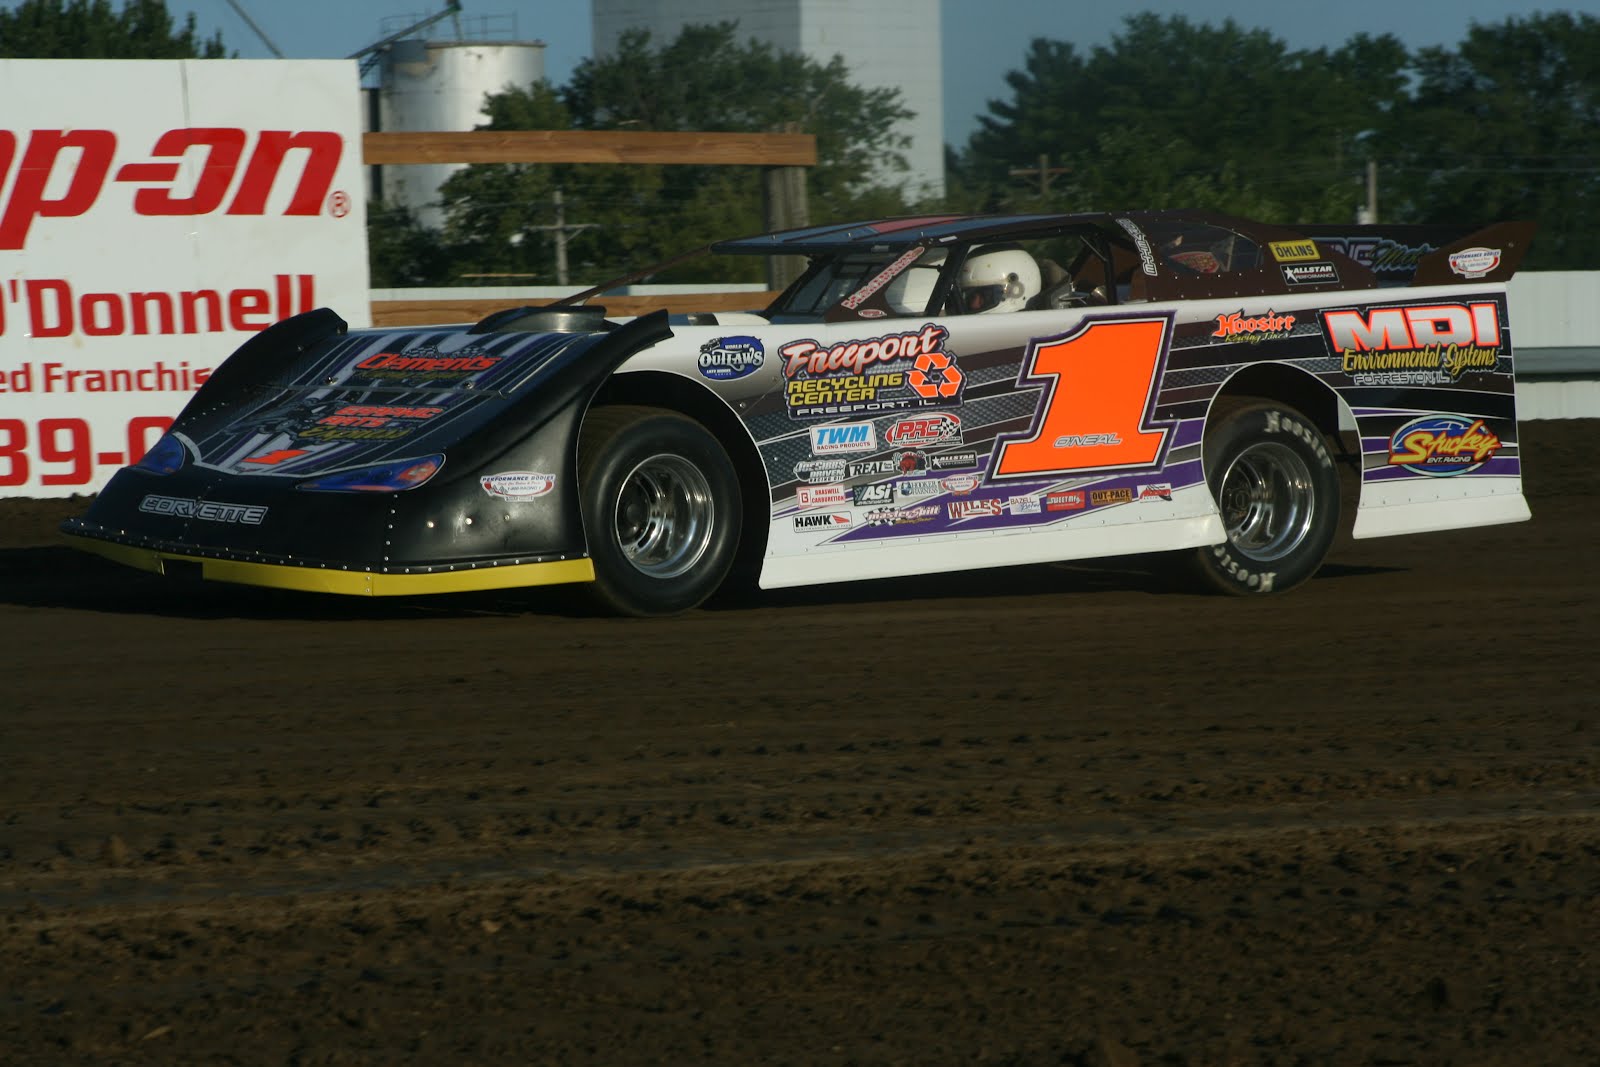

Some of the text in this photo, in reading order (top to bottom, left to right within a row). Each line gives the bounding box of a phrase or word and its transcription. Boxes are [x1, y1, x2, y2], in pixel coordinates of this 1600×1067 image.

[0, 128, 344, 251] p-on
[1274, 244, 1315, 257] ÖHLINS
[1293, 265, 1332, 274] ALLSTAR
[0, 274, 314, 338] 'Donnell
[1211, 310, 1296, 337] Hoosier
[1323, 303, 1500, 353] MDI
[356, 353, 502, 371] Clements
[783, 326, 943, 378] Freeport
[1343, 342, 1496, 375] Environmental Systems
[788, 373, 903, 394] RECYCLING
[790, 388, 875, 406] CENTER
[993, 317, 1168, 478] 1
[816, 425, 869, 445] TWM
[896, 419, 941, 440] PRC
[1390, 419, 1501, 463] Stuckey
[810, 469, 845, 479] DRIVEN
[850, 461, 881, 477] REAL
[814, 487, 840, 495] BRASWELL
[912, 481, 936, 489] HOOKER
[912, 487, 938, 495] HARNESS
[1092, 489, 1131, 500] OUT-PACE
[139, 495, 268, 524] CORVETTE
[948, 498, 1002, 519] WILES
[795, 514, 832, 527] HAWK
